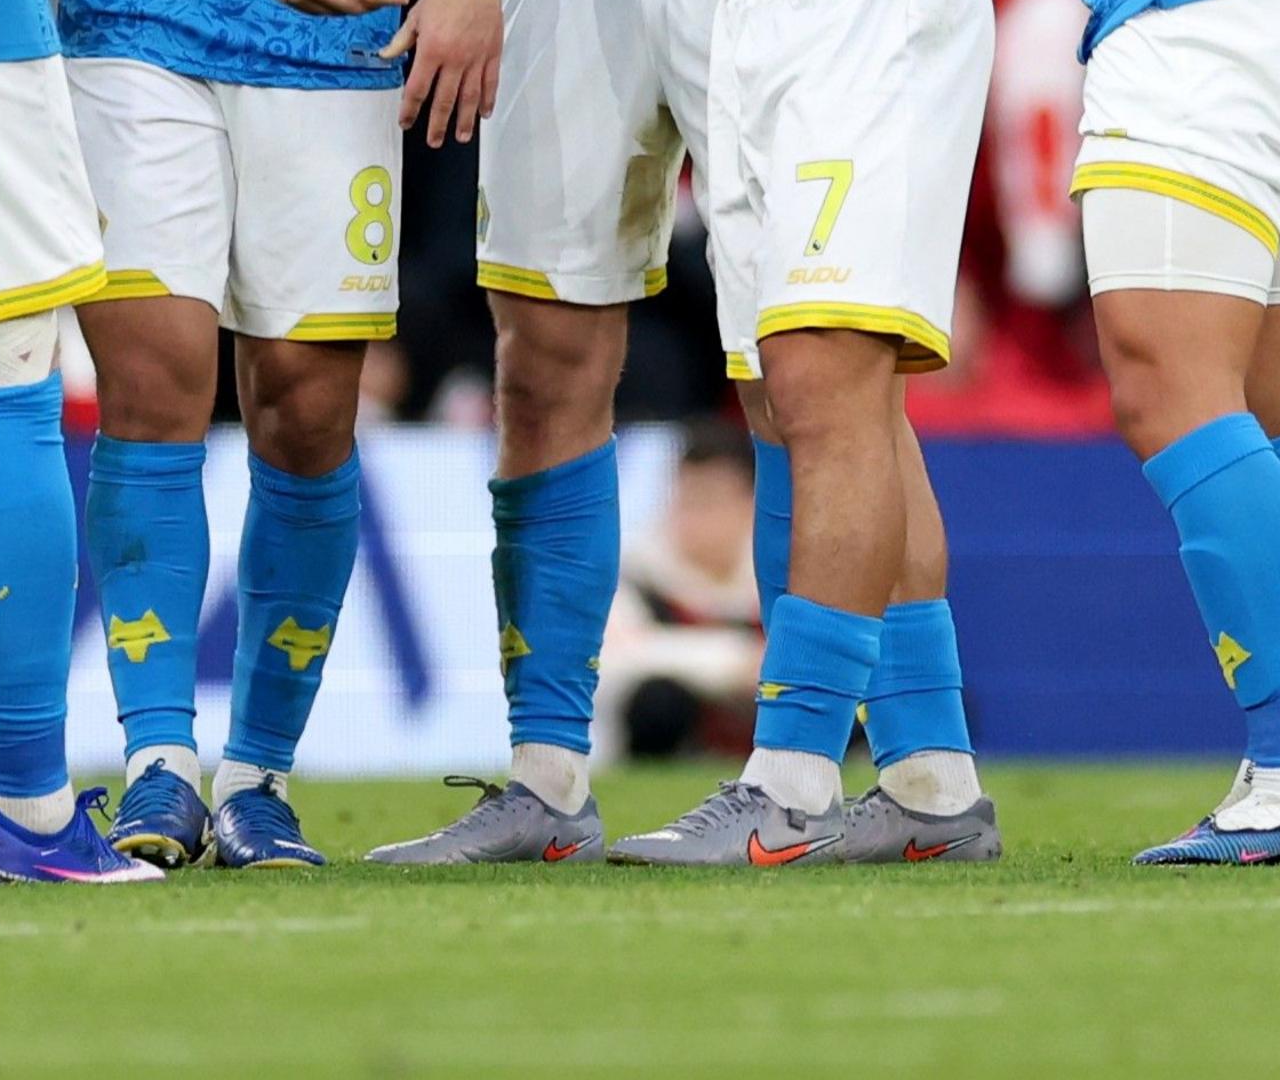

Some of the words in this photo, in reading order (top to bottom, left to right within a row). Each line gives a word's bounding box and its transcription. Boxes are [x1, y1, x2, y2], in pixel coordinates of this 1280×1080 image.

[344, 164, 394, 265] 8
[795, 158, 854, 257] 7
[338, 273, 392, 292] SUDU
[785, 265, 852, 285] SUDU
